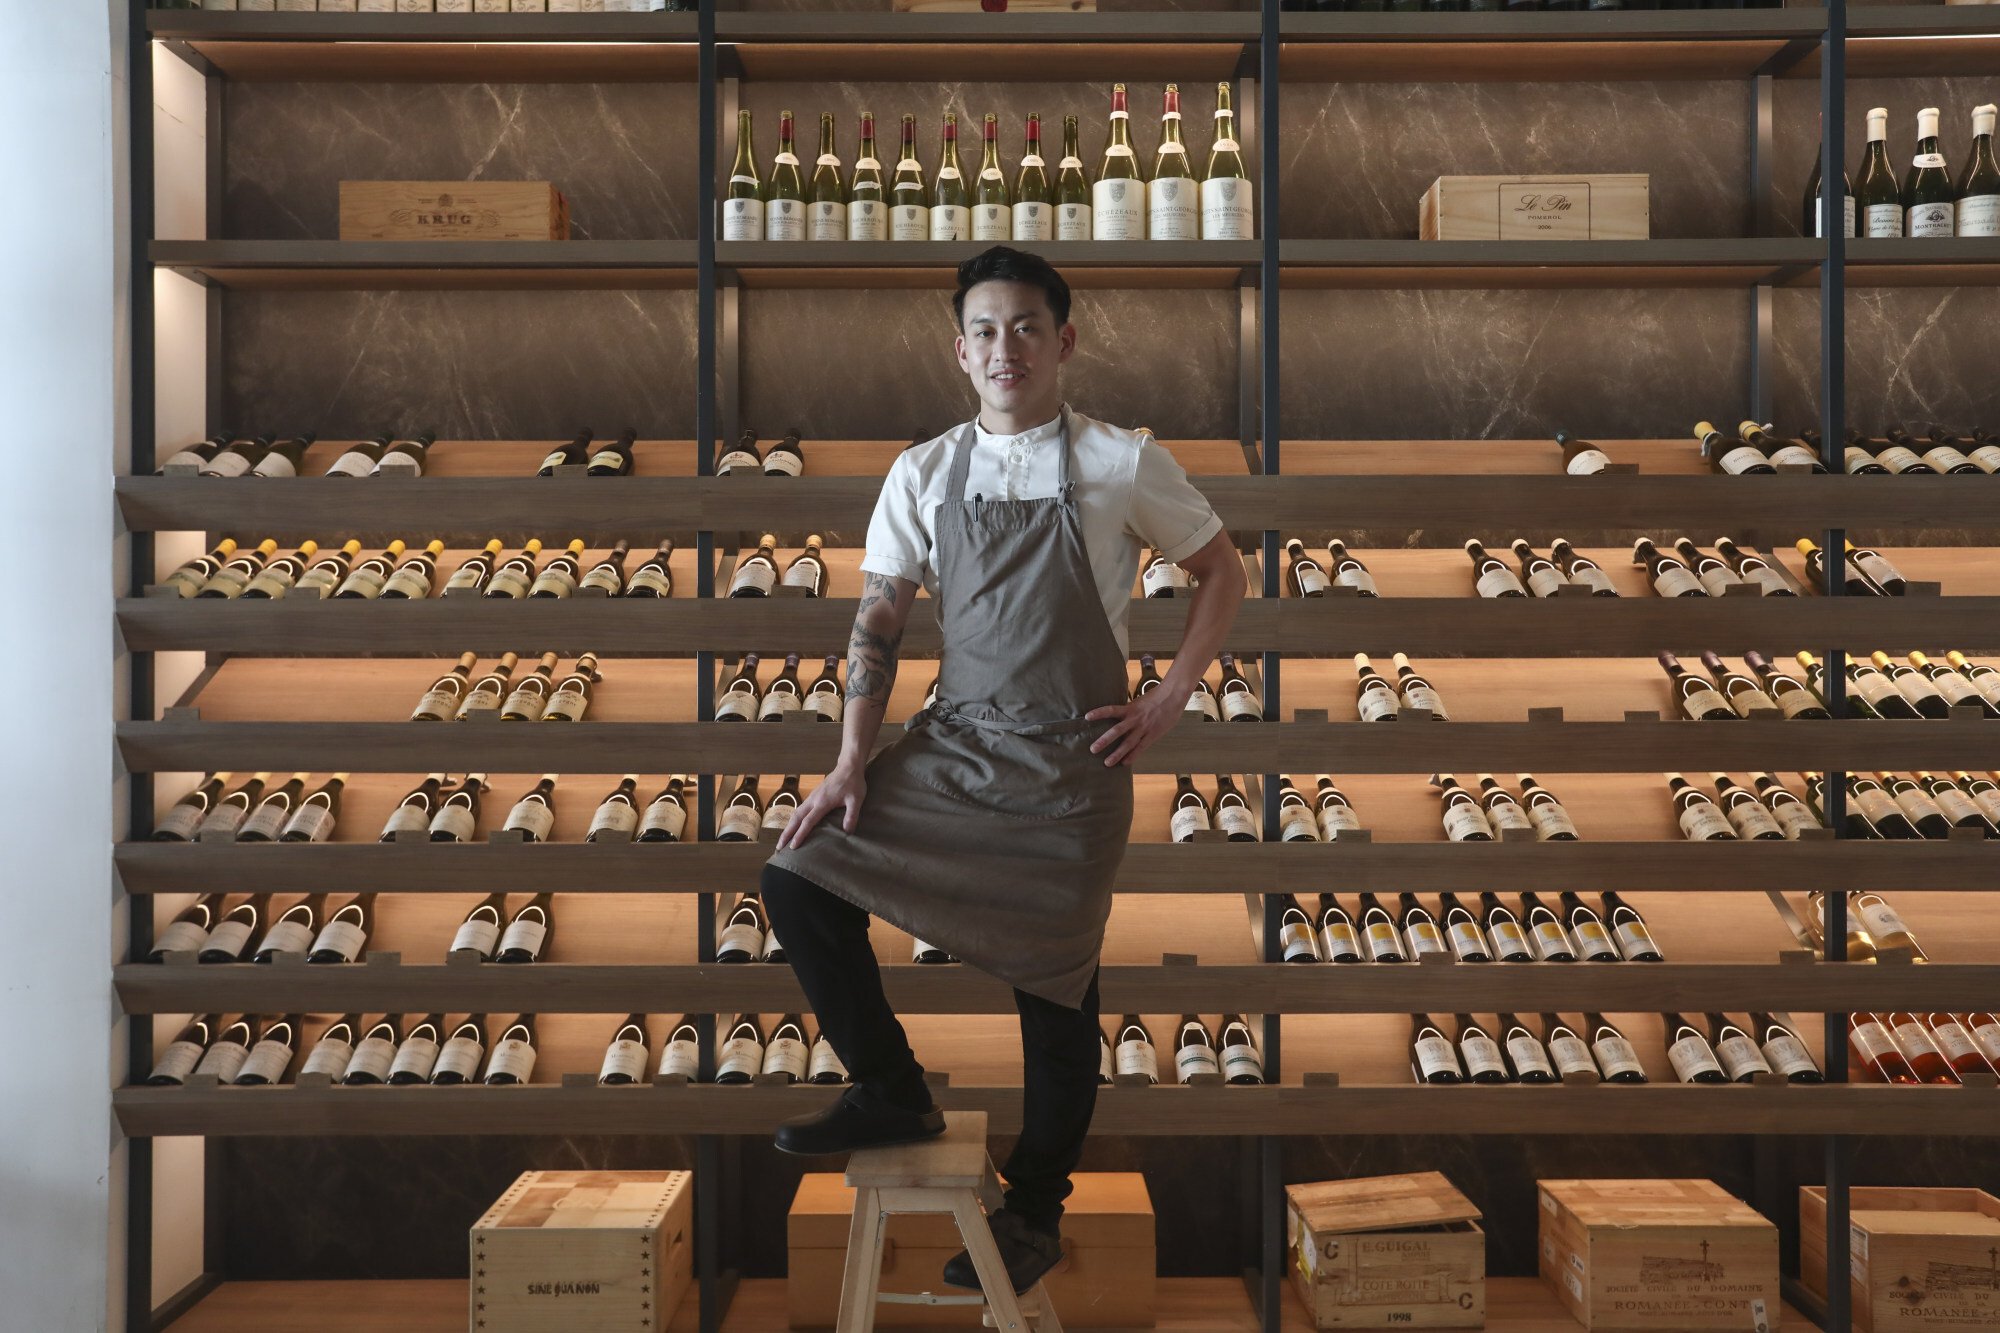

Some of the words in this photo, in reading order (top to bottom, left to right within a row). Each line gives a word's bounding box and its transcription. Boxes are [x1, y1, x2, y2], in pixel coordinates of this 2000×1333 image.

[1514, 194, 1541, 211] Le
[1541, 194, 1572, 211] Pin
[417, 214, 472, 225] KRUG
[1324, 1242, 1339, 1260] C
[527, 1284, 552, 1295] SINE
[576, 1283, 600, 1294] NON
[1687, 1285, 1701, 1293] DU
[1710, 1284, 1764, 1293] DOMAINE
[1458, 1292, 1474, 1310] C
[1974, 1292, 1989, 1301] DU
[1387, 1313, 1412, 1322] 1998
